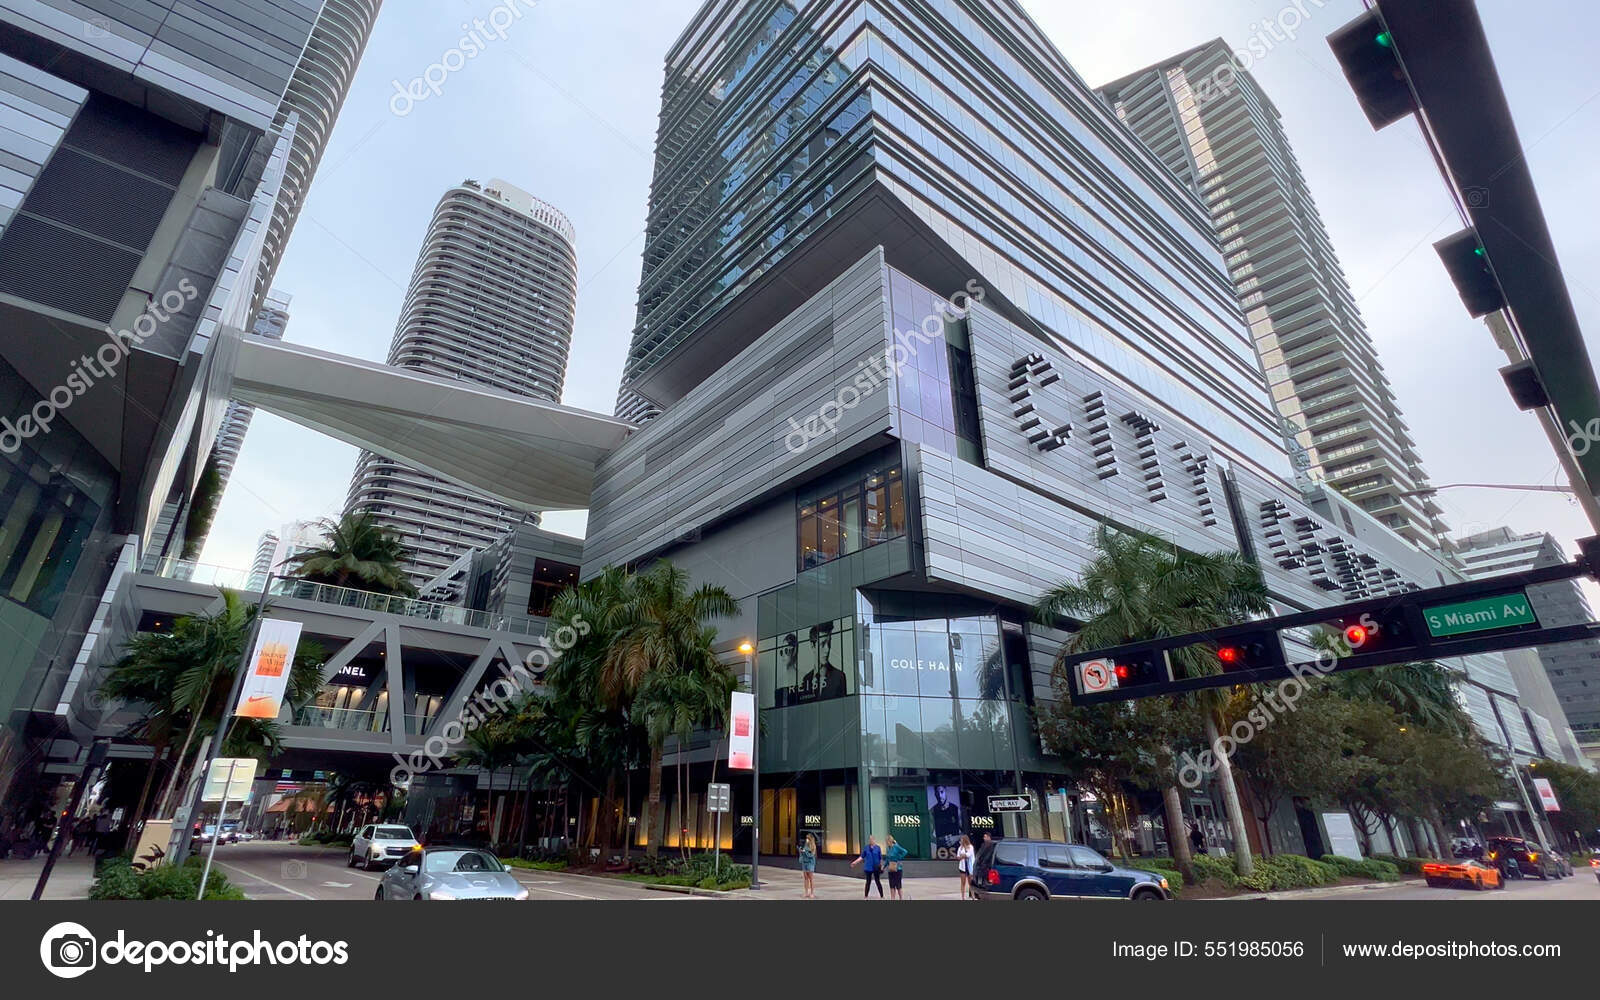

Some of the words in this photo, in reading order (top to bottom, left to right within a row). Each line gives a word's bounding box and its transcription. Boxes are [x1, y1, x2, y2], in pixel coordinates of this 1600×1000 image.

[1007, 352, 1217, 527] CITY
[1429, 615, 1442, 629] S
[1444, 606, 1497, 627] Miami
[1503, 603, 1526, 619] Av
[890, 659, 924, 671] COLE
[928, 661, 962, 673] HAN
[894, 815, 920, 824] BOSS
